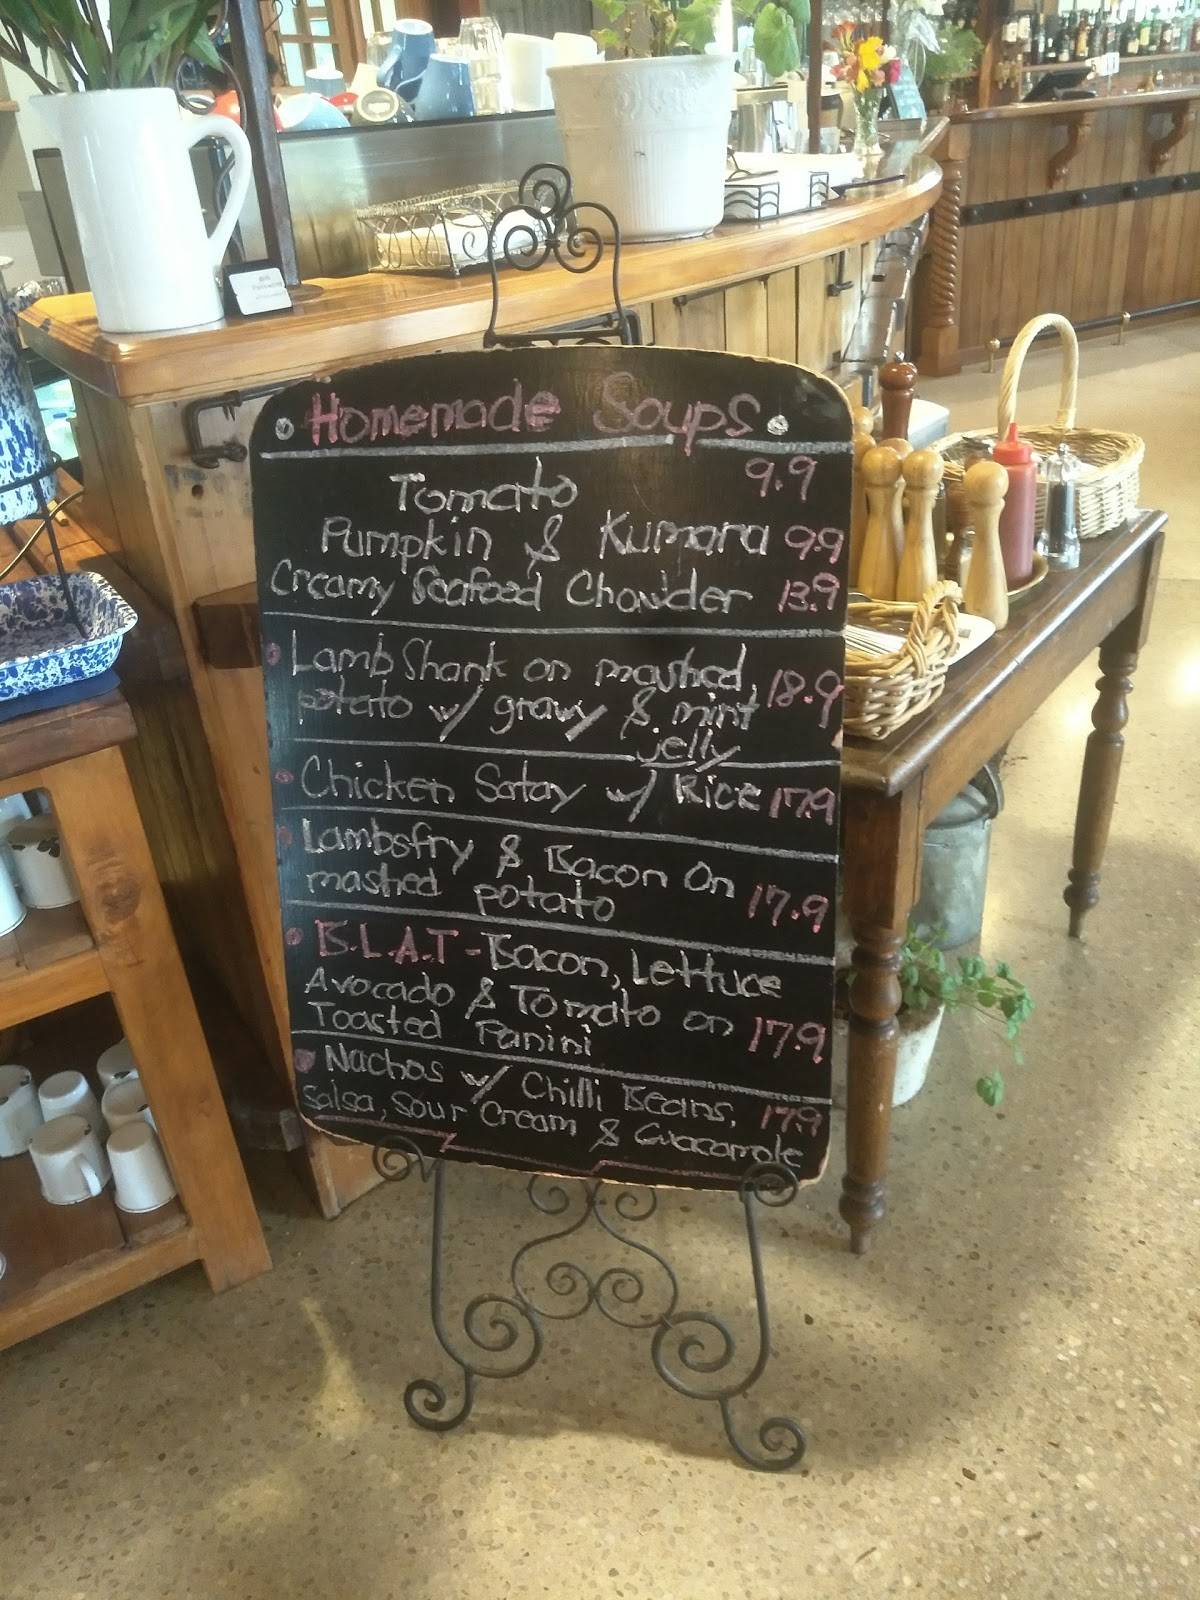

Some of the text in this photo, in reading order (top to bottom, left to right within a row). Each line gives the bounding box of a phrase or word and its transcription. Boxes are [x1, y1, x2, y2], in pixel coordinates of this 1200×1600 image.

[305, 371, 761, 456] Homemade Soups
[389, 455, 818, 514] Tomato 9.9
[321, 515, 492, 575] Pumpkin
[600, 509, 770, 559] Kumara
[784, 525, 844, 564] 9.9
[270, 558, 395, 616] Creamy
[777, 571, 840, 613] 13.9
[290, 629, 394, 678] Lamb
[402, 637, 507, 682] Shank
[523, 658, 572, 683] on
[767, 669, 845, 729] 18.9
[297, 674, 414, 725] potato
[301, 754, 455, 804] Chicken
[474, 762, 587, 814] Satay
[674, 772, 762, 811] Rice
[768, 786, 836, 826] 17.9
[473, 874, 616, 923] potato
[544, 844, 668, 889] Bacon
[747, 884, 830, 934] 17.9
[303, 966, 456, 1008] Avocado
[509, 982, 661, 1028] Tomato
[682, 1010, 734, 1037] on
[747, 1016, 827, 1064] 17.9
[306, 1001, 442, 1040] Toasted
[324, 1042, 444, 1084] Nachos
[760, 1104, 823, 1138] 17.9
[390, 1090, 468, 1122] Sour
[479, 1099, 577, 1137] Cream
